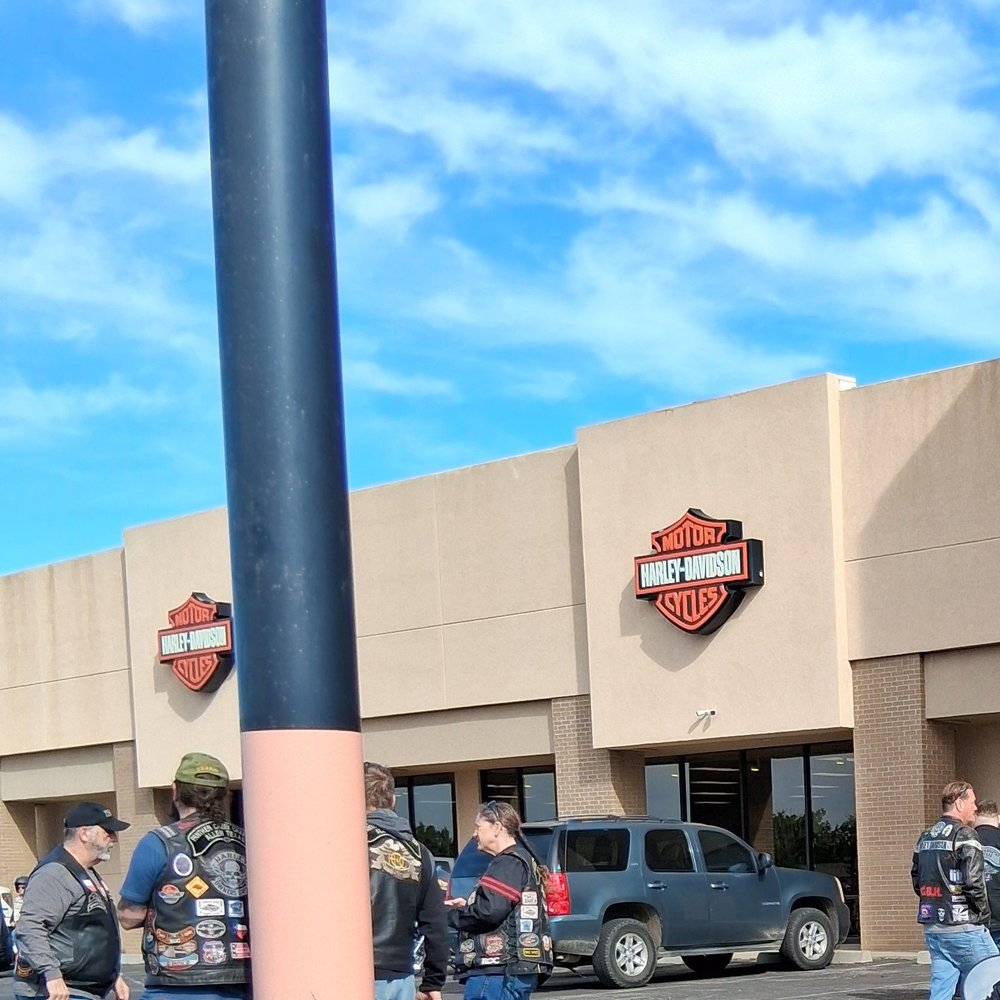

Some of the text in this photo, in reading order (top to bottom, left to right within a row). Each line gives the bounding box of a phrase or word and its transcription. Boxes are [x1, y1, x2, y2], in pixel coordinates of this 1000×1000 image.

[662, 520, 716, 551] MOTOR
[640, 548, 741, 588] HARLEY-DAVIDSON
[174, 602, 211, 627] MOTOR
[664, 586, 718, 623] CYCLES
